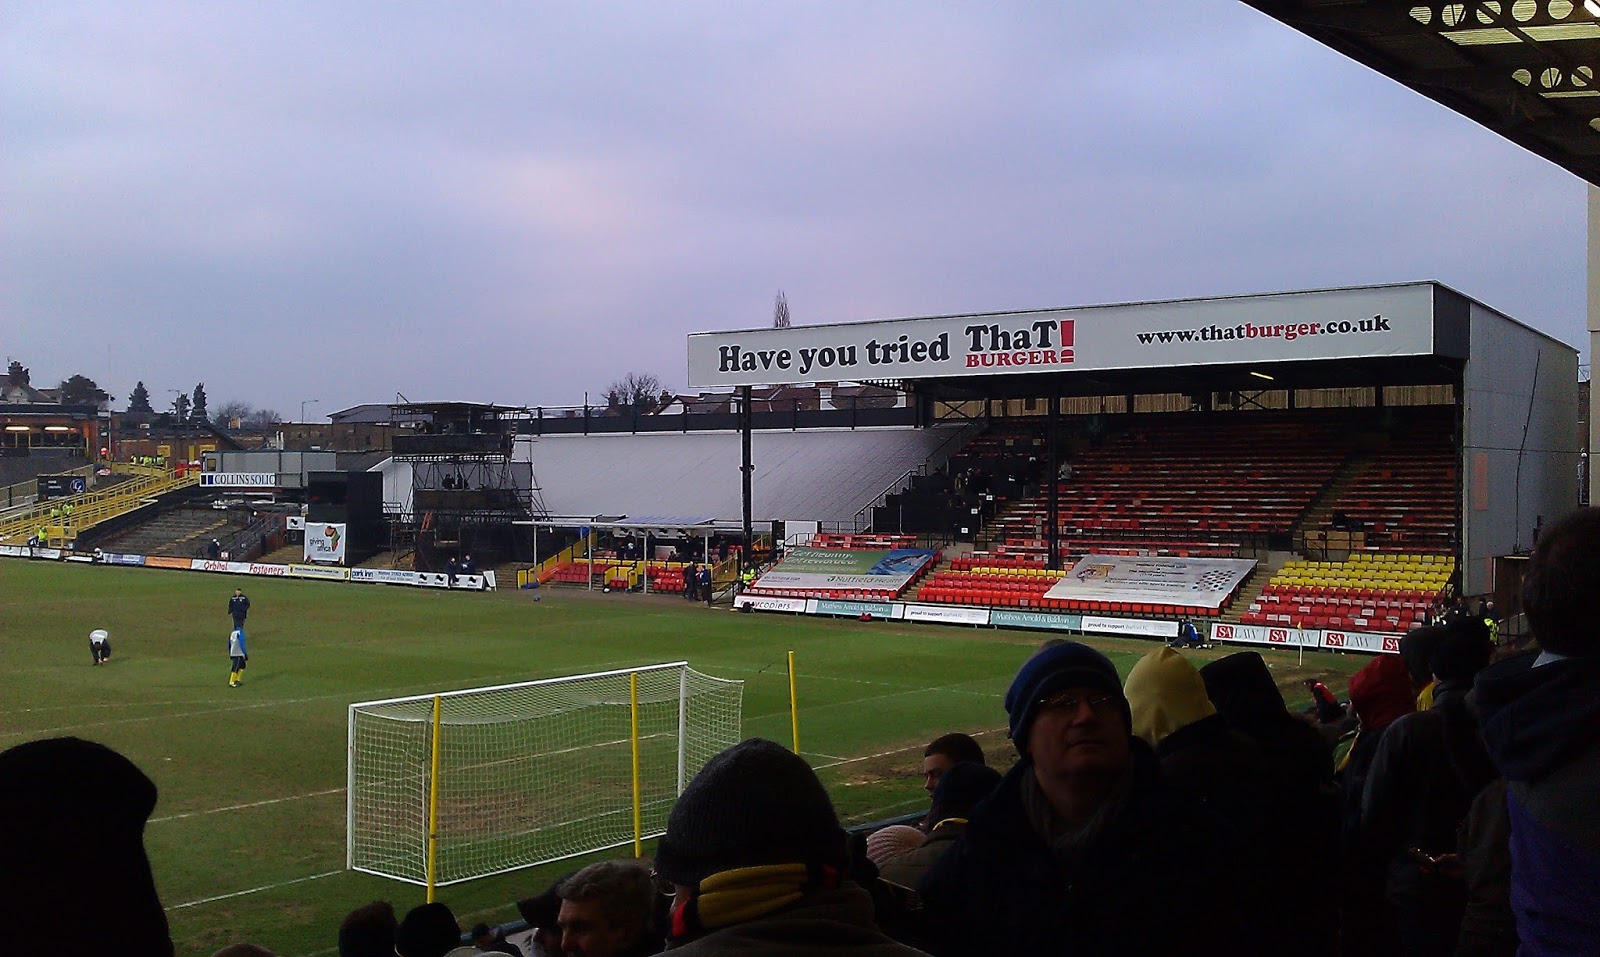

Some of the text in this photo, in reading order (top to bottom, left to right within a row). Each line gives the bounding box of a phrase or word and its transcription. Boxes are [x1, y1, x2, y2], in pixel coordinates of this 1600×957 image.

[1136, 314, 1391, 345] www.thatburger.co.uk
[718, 331, 950, 375] Have you tried
[965, 350, 1058, 368] BURGER
[214, 474, 249, 485] COLLINS
[310, 537, 324, 546] giving
[204, 561, 228, 570] Orbital
[248, 563, 285, 575] Fasteners
[352, 569, 364, 578] park
[843, 603, 860, 611] Arnold
[1021, 614, 1041, 622] Arnold
[1218, 626, 1259, 639] SA LAW
[1271, 630, 1285, 642] SA
[1328, 633, 1371, 647] SA LAW
[1385, 638, 1399, 650] SA
